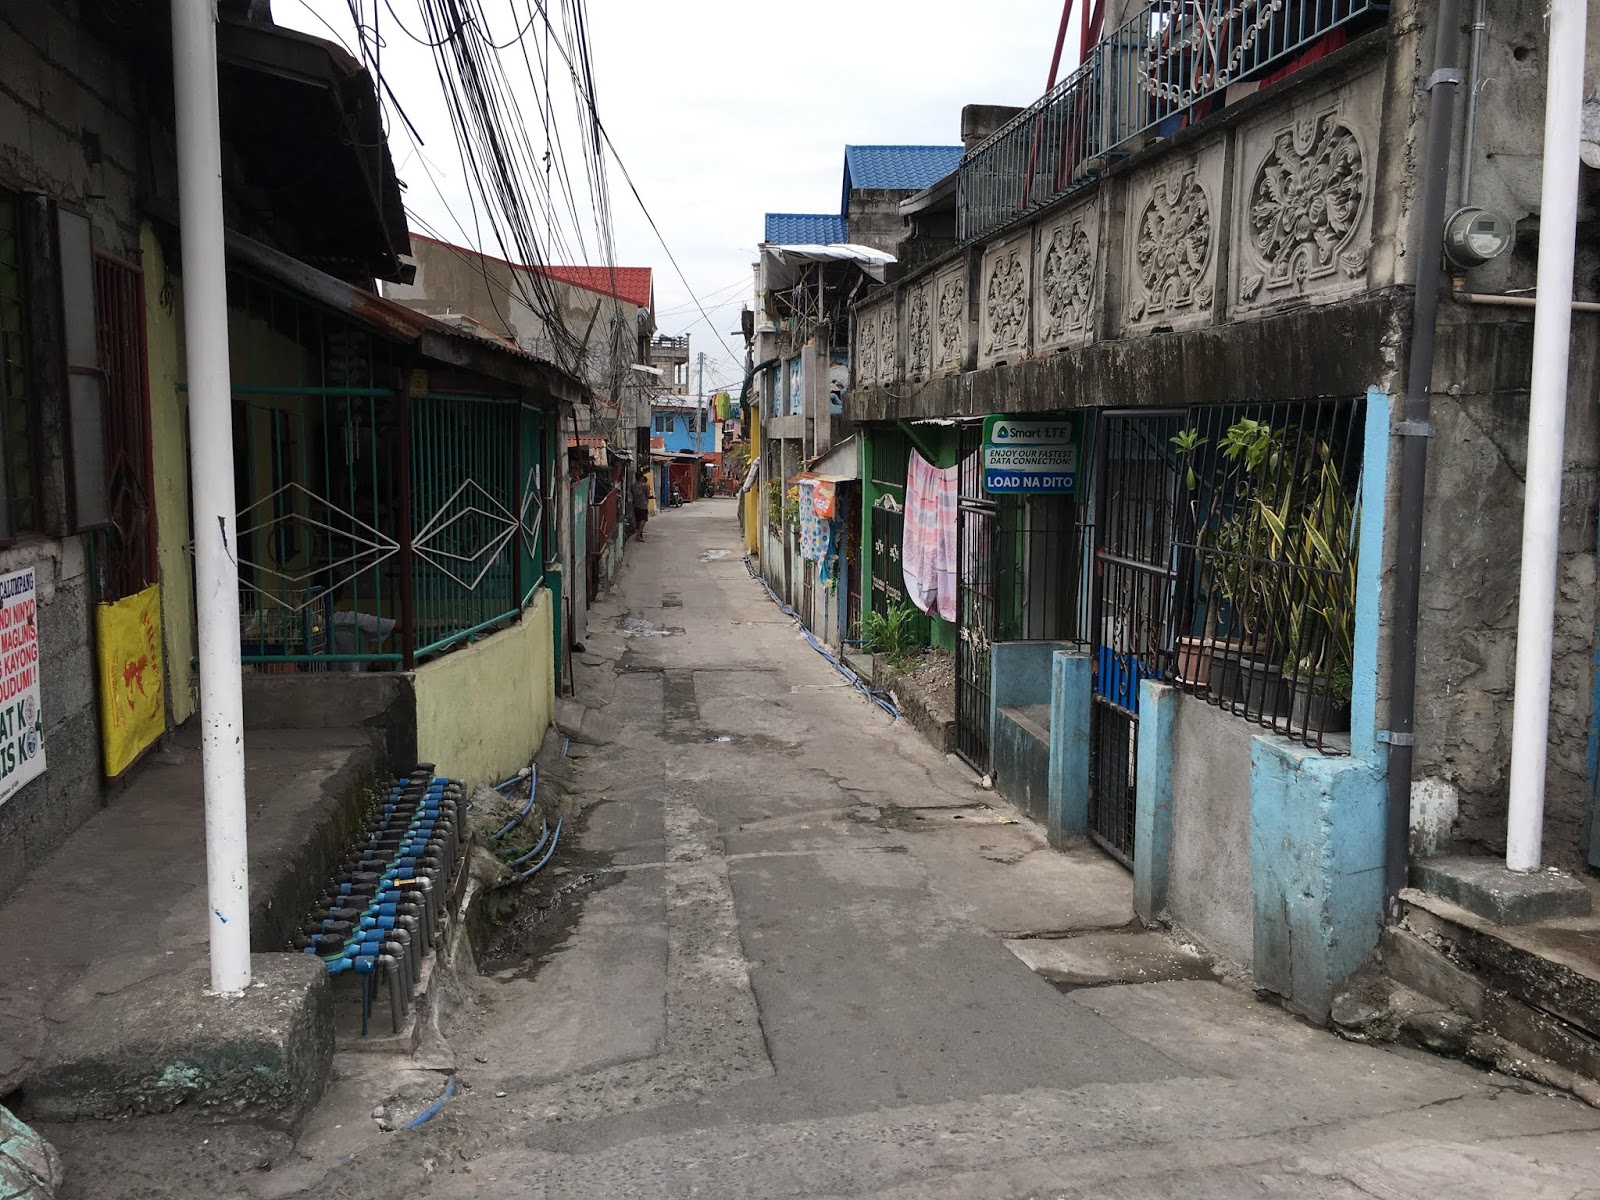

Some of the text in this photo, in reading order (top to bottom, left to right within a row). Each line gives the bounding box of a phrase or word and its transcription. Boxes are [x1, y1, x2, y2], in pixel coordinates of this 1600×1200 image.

[1010, 428, 1067, 438] Smart LTE
[987, 477, 1073, 487] LOAD NA DITO
[13, 598, 35, 625] NINYO
[4, 642, 37, 676] KAYONG
